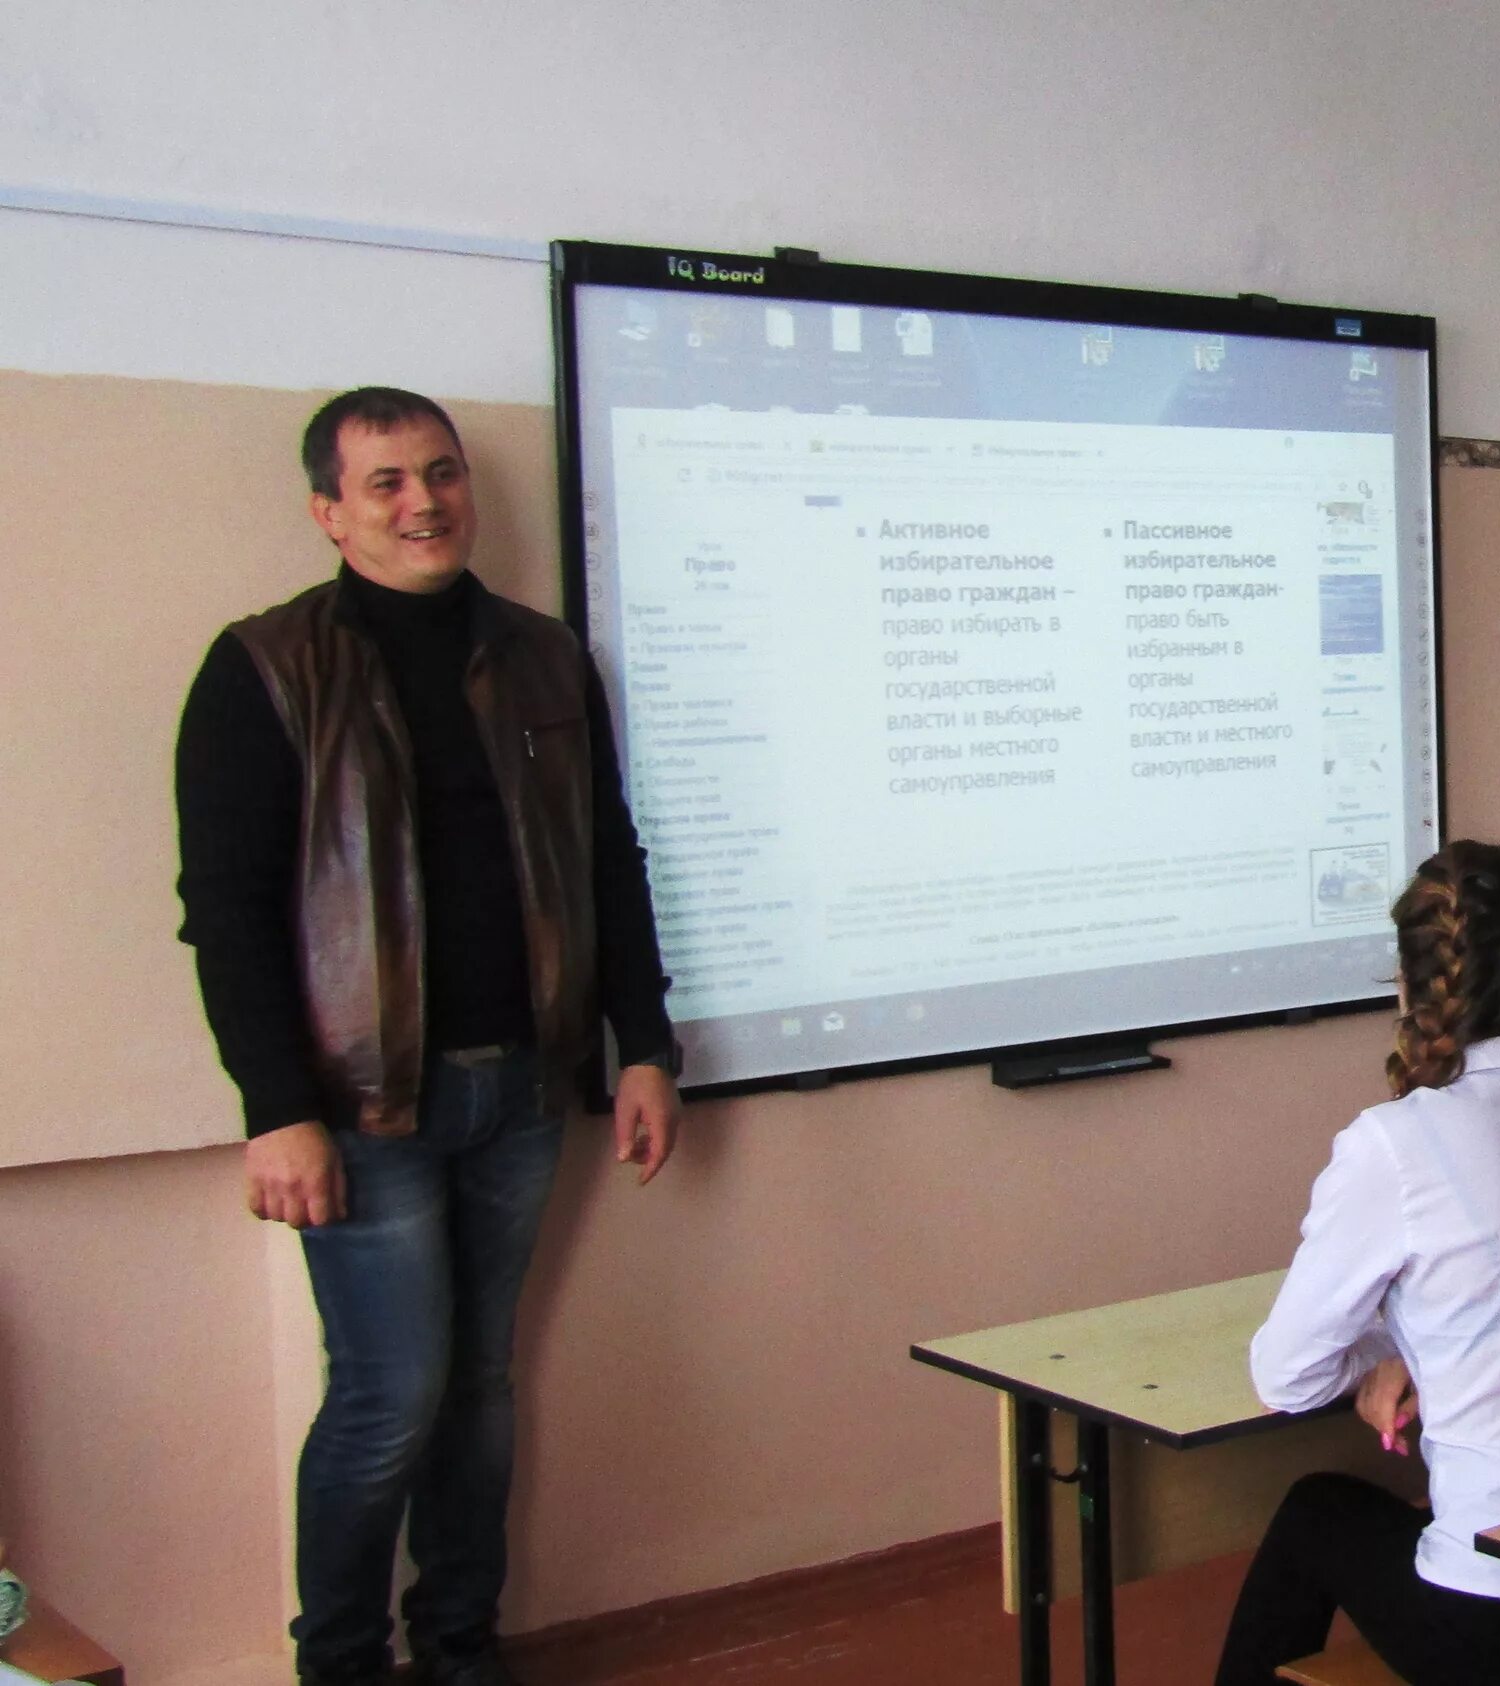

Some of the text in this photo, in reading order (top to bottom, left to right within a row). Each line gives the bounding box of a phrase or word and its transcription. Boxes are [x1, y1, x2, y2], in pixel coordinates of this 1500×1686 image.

[668, 256, 765, 284] IQ Board
[879, 519, 990, 540] Активное
[1123, 520, 1233, 540] Пассивное
[685, 556, 736, 575] Право
[880, 550, 1054, 575] избирательное
[1123, 550, 1276, 574] избирательное
[881, 587, 952, 606] право
[958, 586, 1056, 607] граждан
[1125, 584, 1188, 603] право
[882, 613, 1061, 638] право избирать в
[1126, 608, 1229, 633] право быть
[884, 650, 959, 669] органы
[1127, 639, 1244, 661] избранным в
[885, 672, 1056, 701] государственной
[1128, 672, 1193, 690] органы
[887, 705, 1083, 731] власти и выборные
[1129, 694, 1278, 721] государственной
[1130, 724, 1293, 748] власти и местного
[888, 738, 1059, 765] органы местного
[1131, 755, 1276, 779] самоуправления
[889, 769, 1055, 795] самоуправления
